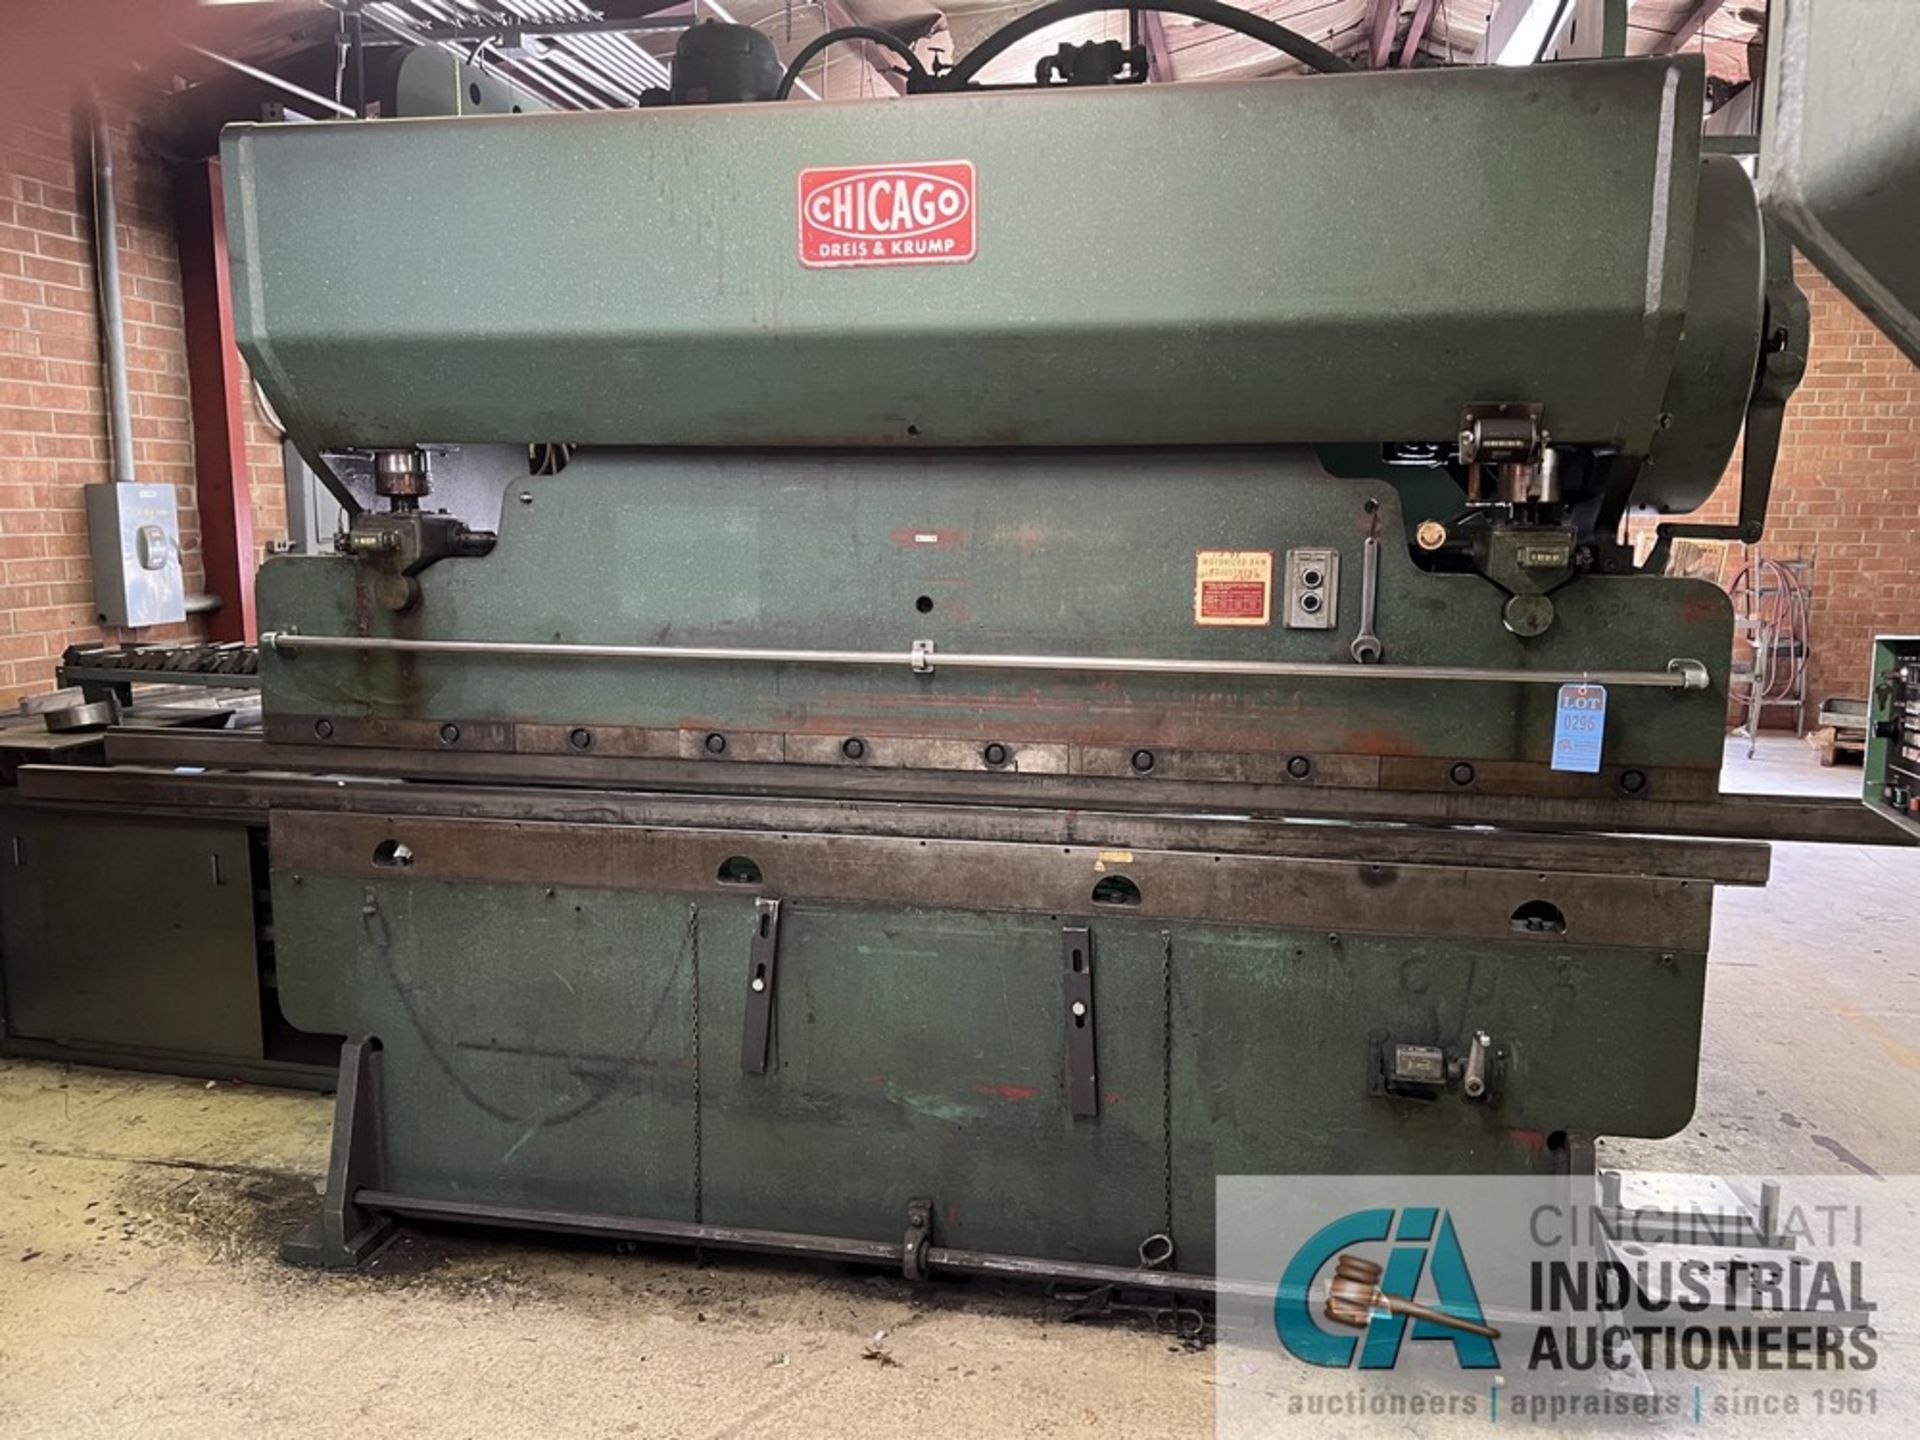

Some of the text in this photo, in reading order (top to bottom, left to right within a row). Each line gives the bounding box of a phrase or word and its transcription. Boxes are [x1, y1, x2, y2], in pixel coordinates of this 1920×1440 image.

[812, 180, 960, 232] CHICAGO
[819, 238, 955, 257] DREIS & KRUMP
[1562, 696, 1600, 710] LOT
[1564, 714, 1597, 732] 0296
